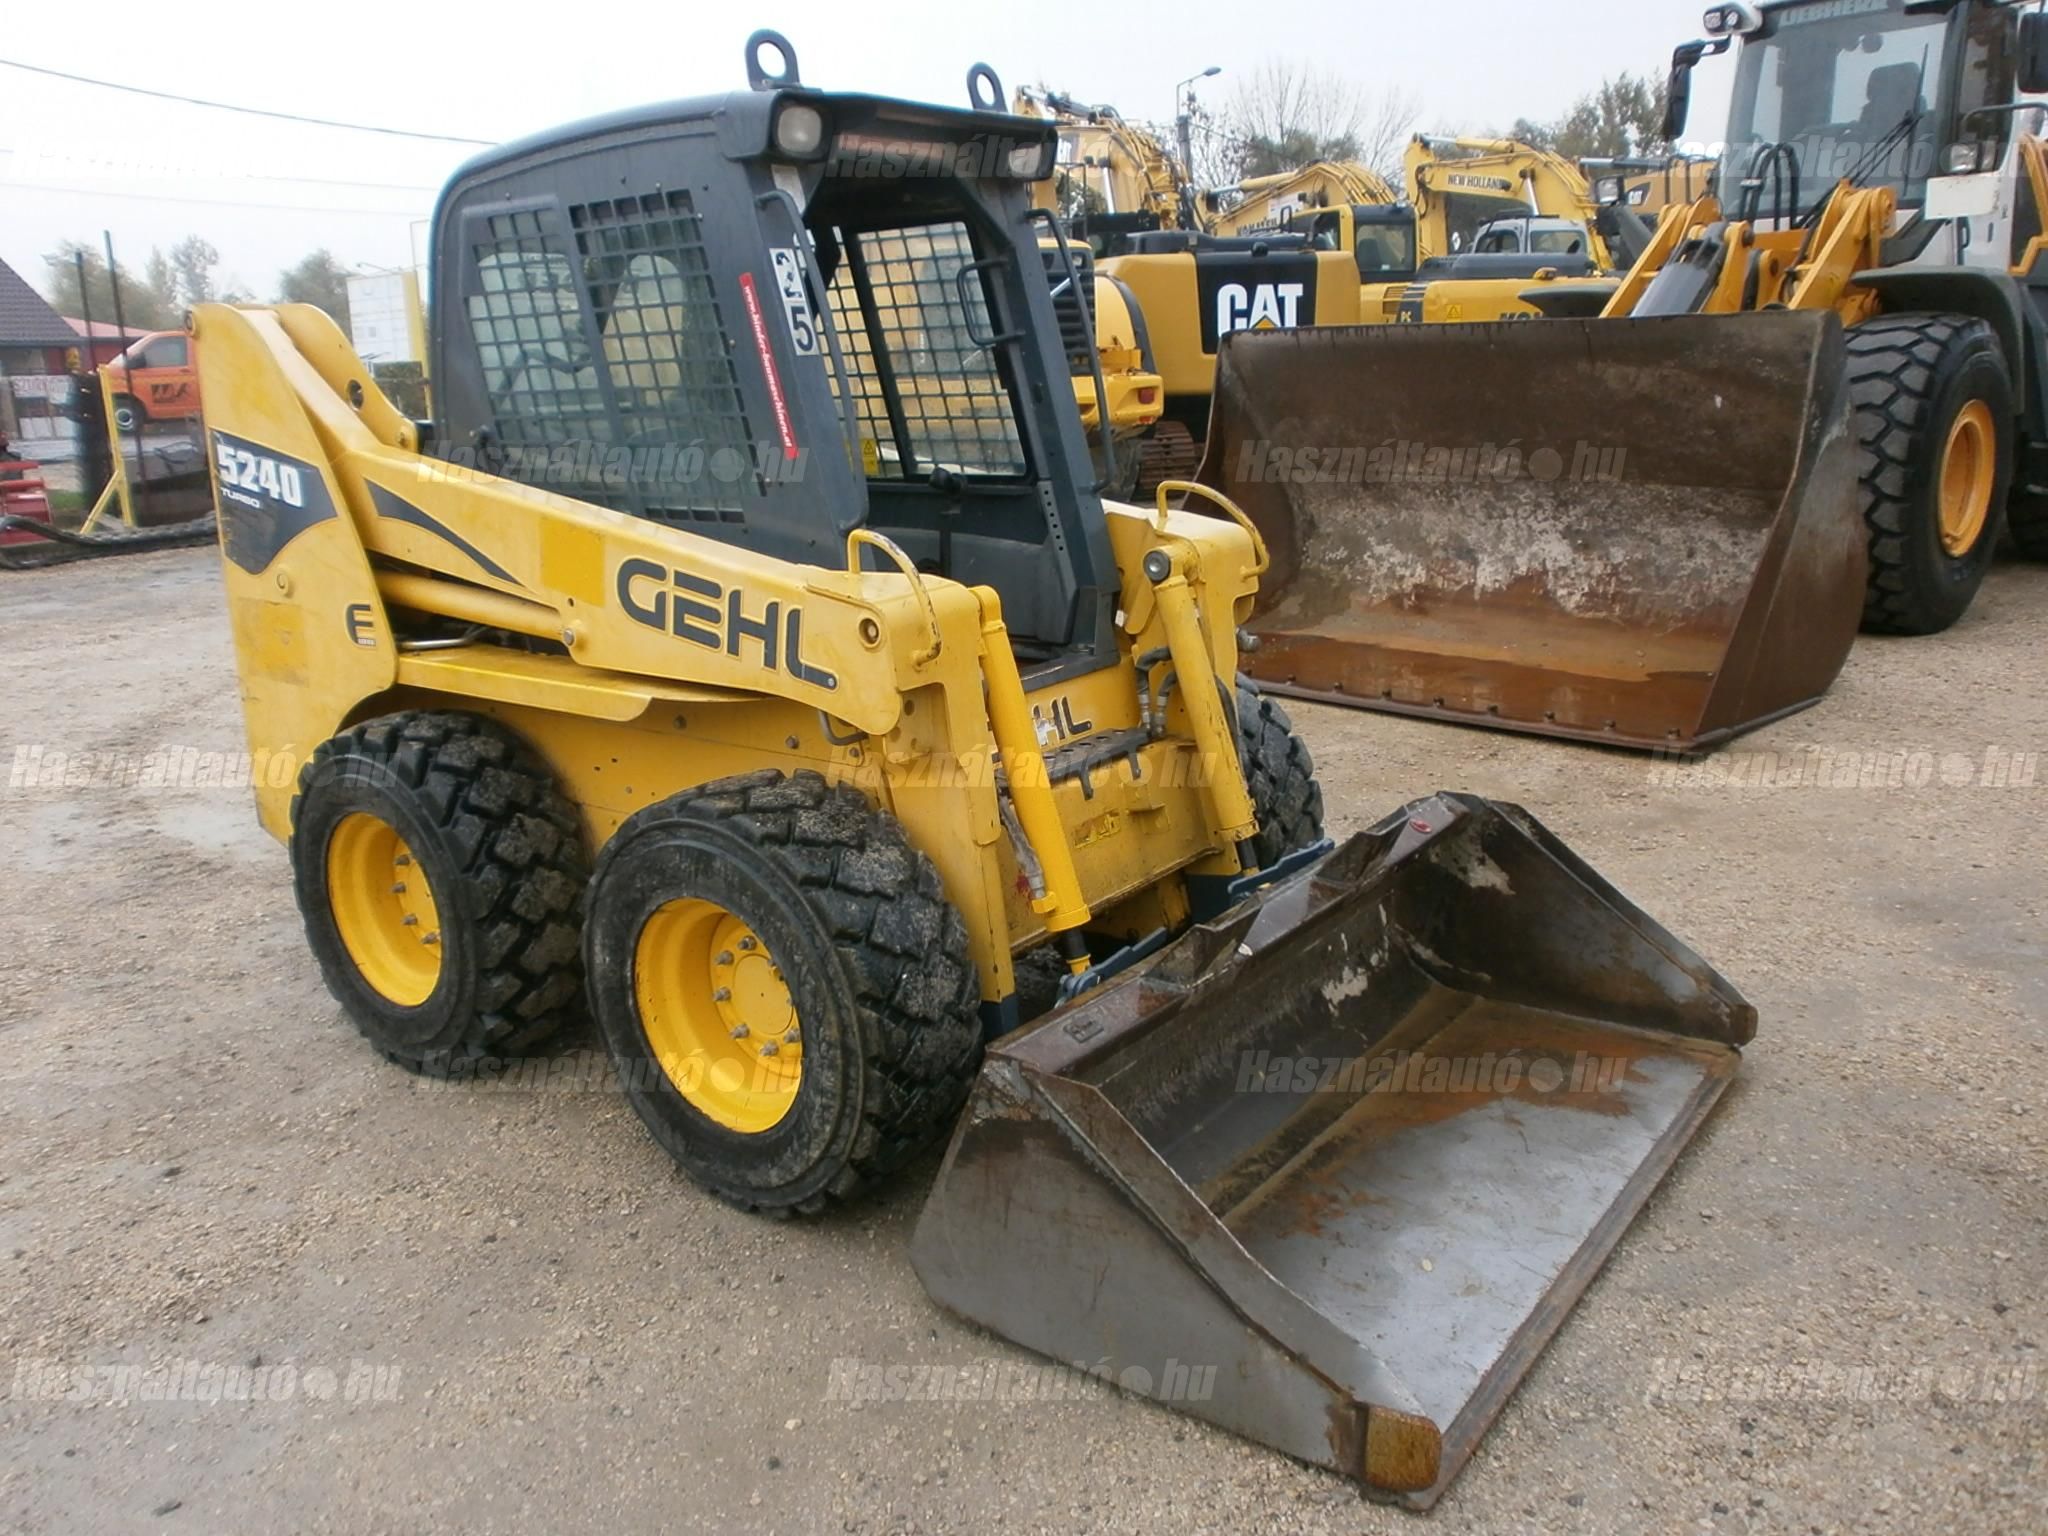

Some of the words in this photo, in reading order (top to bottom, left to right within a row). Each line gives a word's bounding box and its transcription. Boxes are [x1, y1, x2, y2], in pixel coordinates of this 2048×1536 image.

[1448, 174, 1465, 186] NEW
[1217, 284, 1303, 338] CAT
[216, 444, 303, 508] 5240
[220, 487, 261, 508] TURBO
[617, 557, 838, 690] GEHL
[1032, 696, 1093, 747] HL
